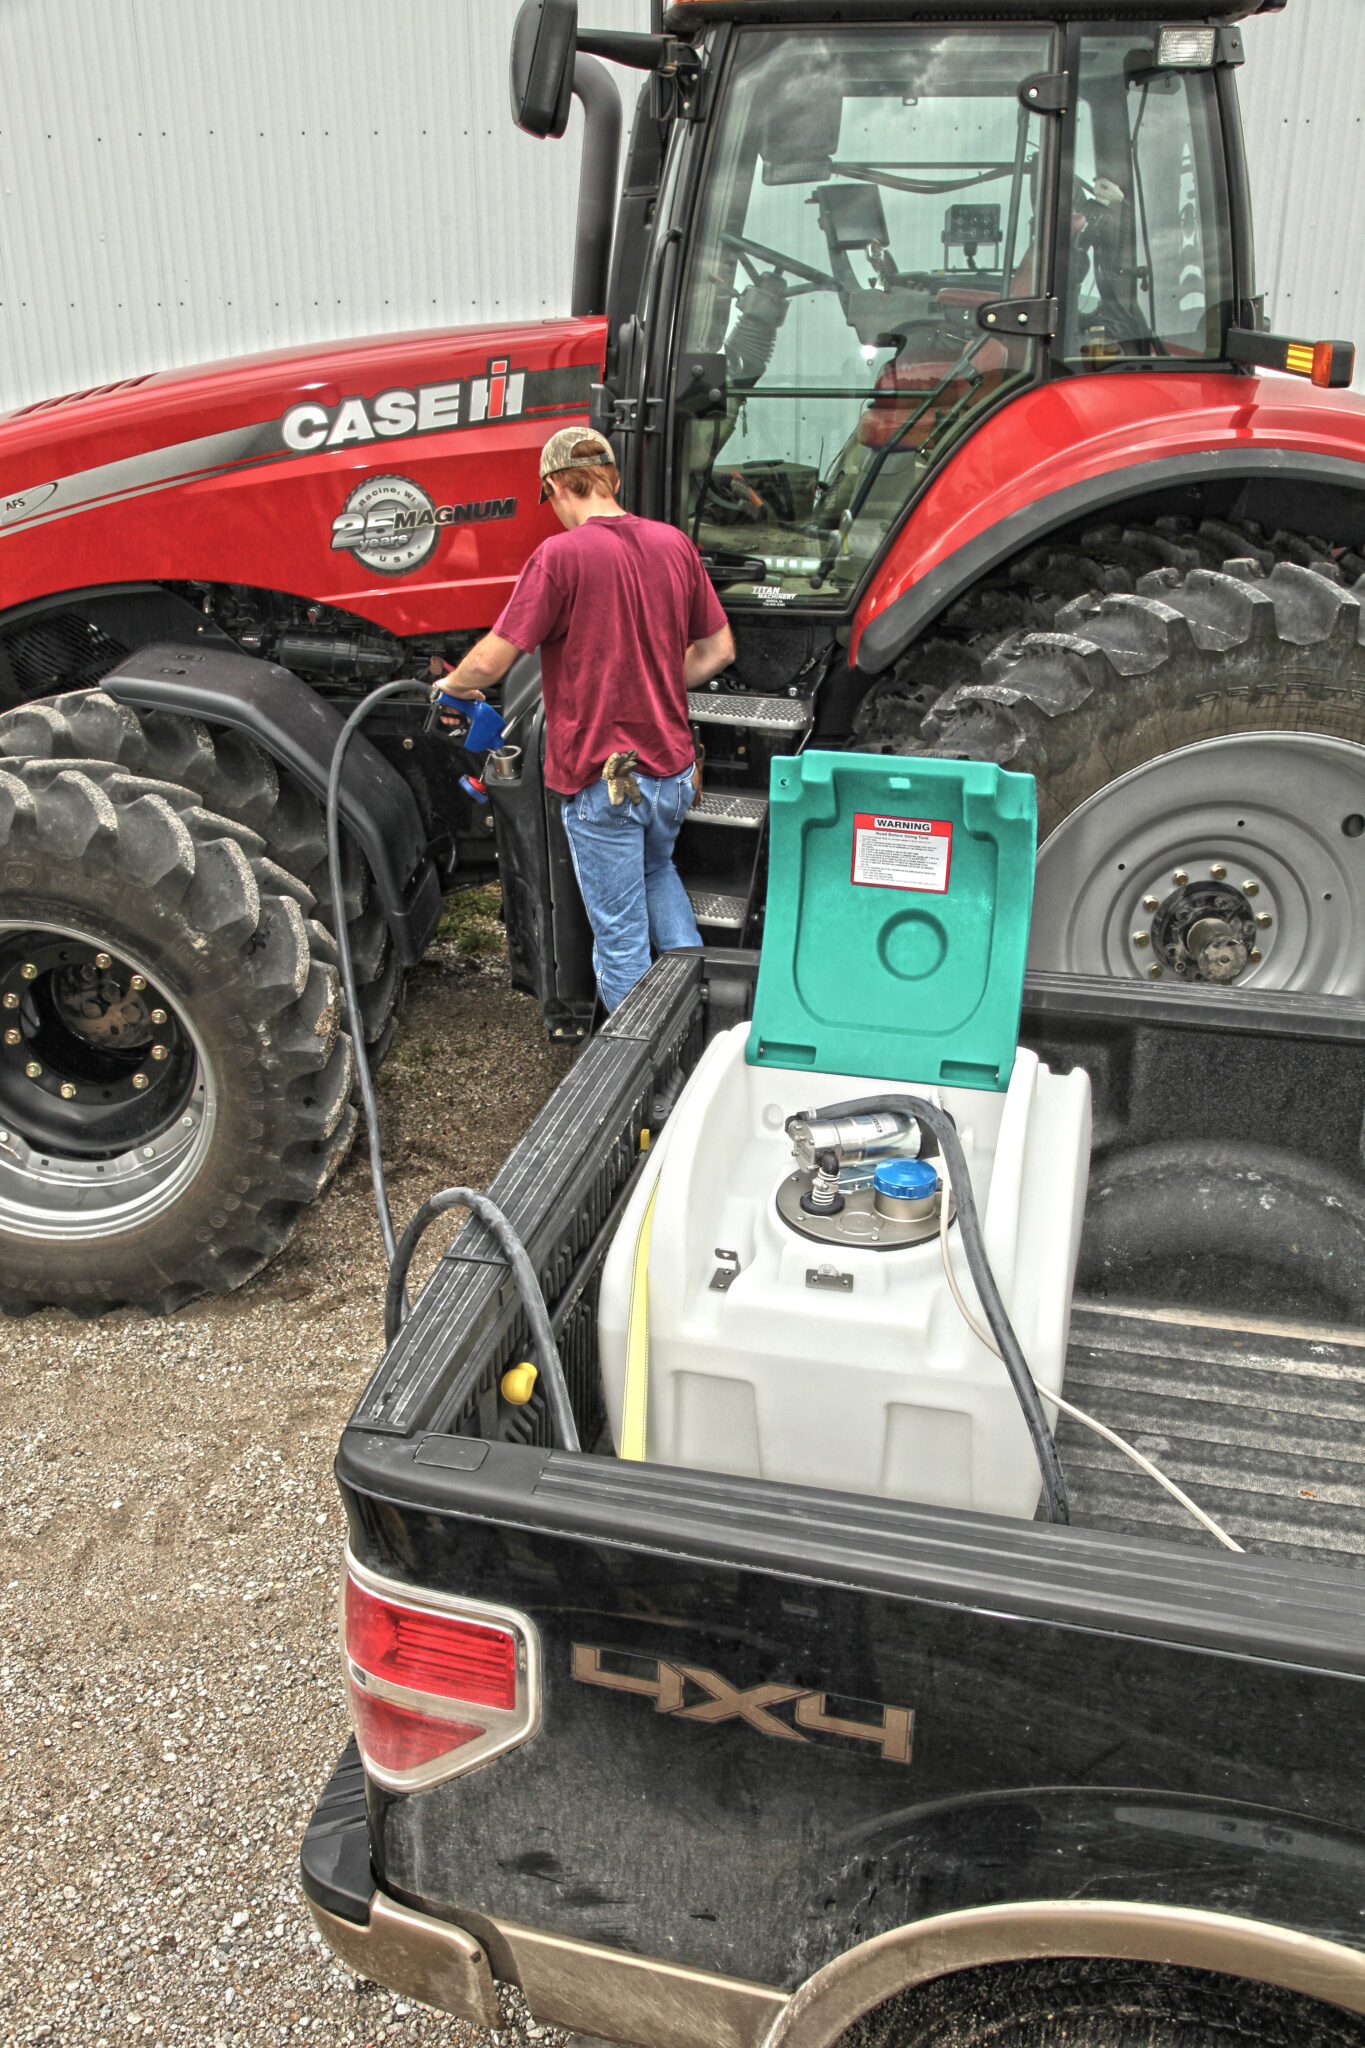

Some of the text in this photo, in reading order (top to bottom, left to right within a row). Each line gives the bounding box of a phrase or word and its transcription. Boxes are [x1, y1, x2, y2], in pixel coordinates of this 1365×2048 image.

[282, 383, 460, 450] CASE
[6, 498, 26, 511] AFS
[358, 487, 401, 507] Racine,
[330, 497, 516, 550] 25 MAGNUM
[359, 534, 409, 552] years
[751, 586, 780, 595] TITAN
[877, 819, 930, 831] WARNING
[571, 1642, 915, 1765] 4X4
